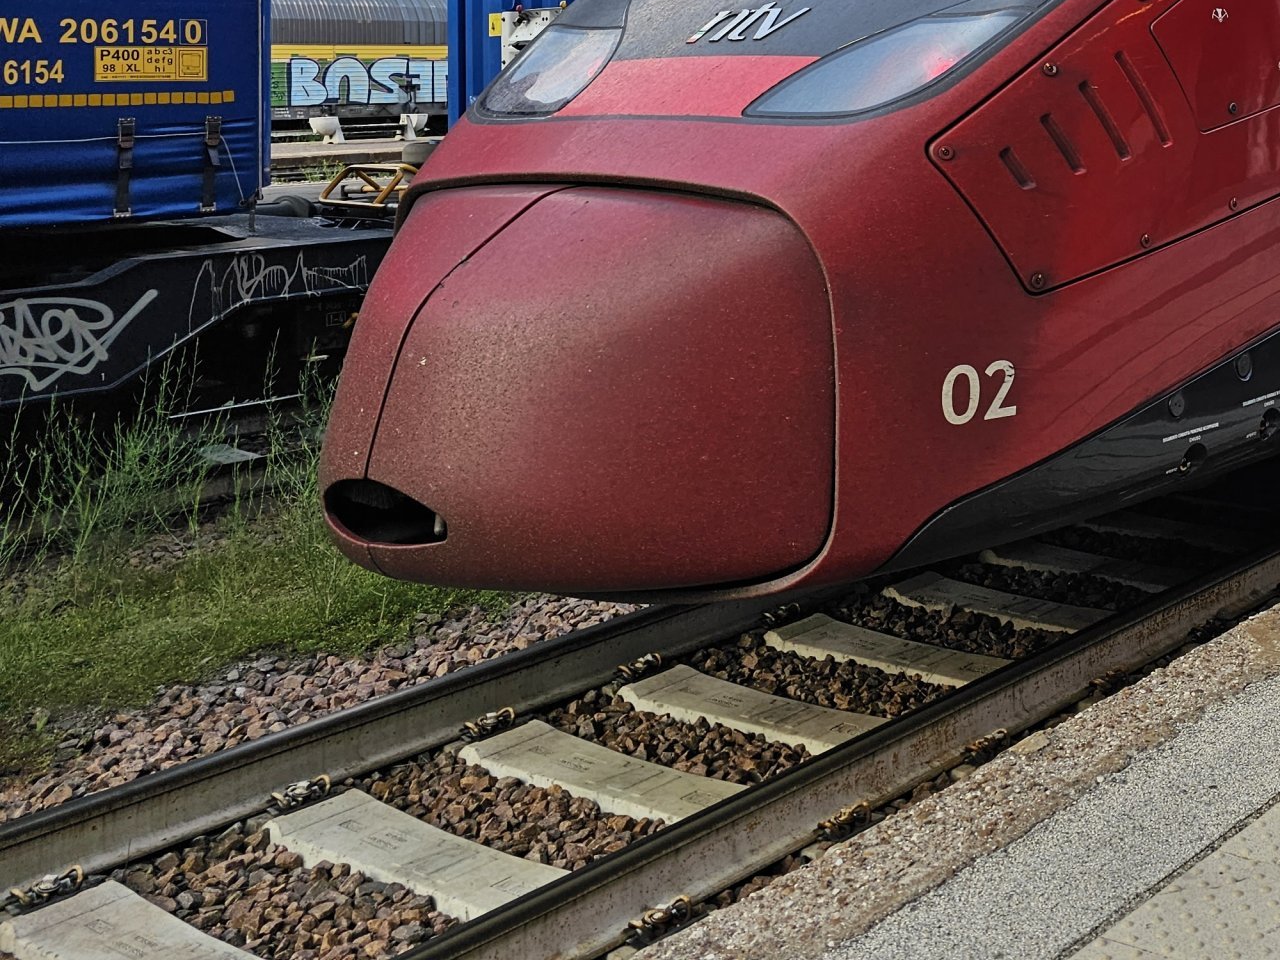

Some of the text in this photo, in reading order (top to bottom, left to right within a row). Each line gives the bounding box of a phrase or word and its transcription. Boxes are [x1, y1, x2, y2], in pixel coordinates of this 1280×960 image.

[100, 49, 140, 61] P400
[4, 60, 64, 85] 6154
[102, 63, 141, 72] 98 XL
[941, 359, 1017, 425] 02
